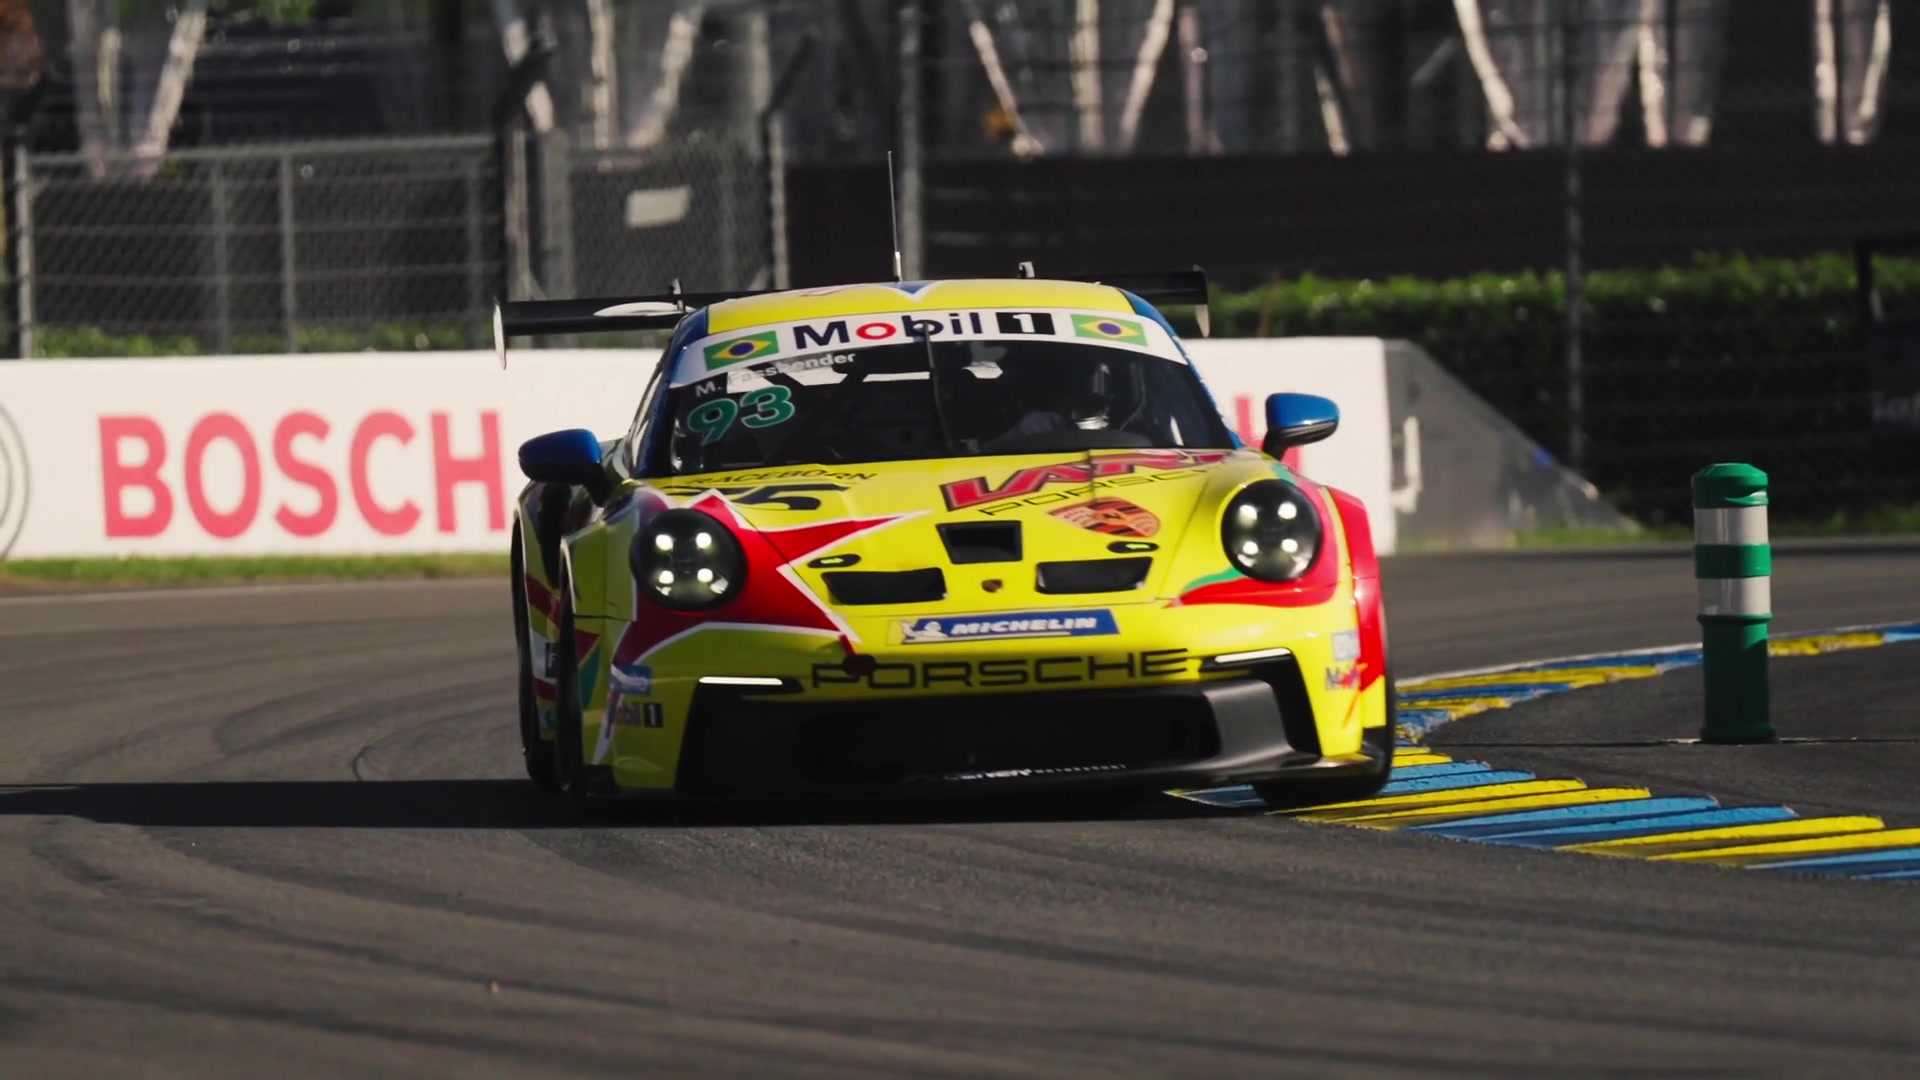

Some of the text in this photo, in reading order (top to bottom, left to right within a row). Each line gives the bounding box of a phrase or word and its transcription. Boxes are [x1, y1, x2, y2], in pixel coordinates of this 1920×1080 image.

[792, 311, 983, 350] Mobil
[695, 351, 856, 398] M. Fassbender
[686, 384, 797, 446] 93
[99, 410, 507, 540] BOSCH
[950, 616, 1099, 636] MICHELIN
[811, 647, 1189, 689] PORSCHE
